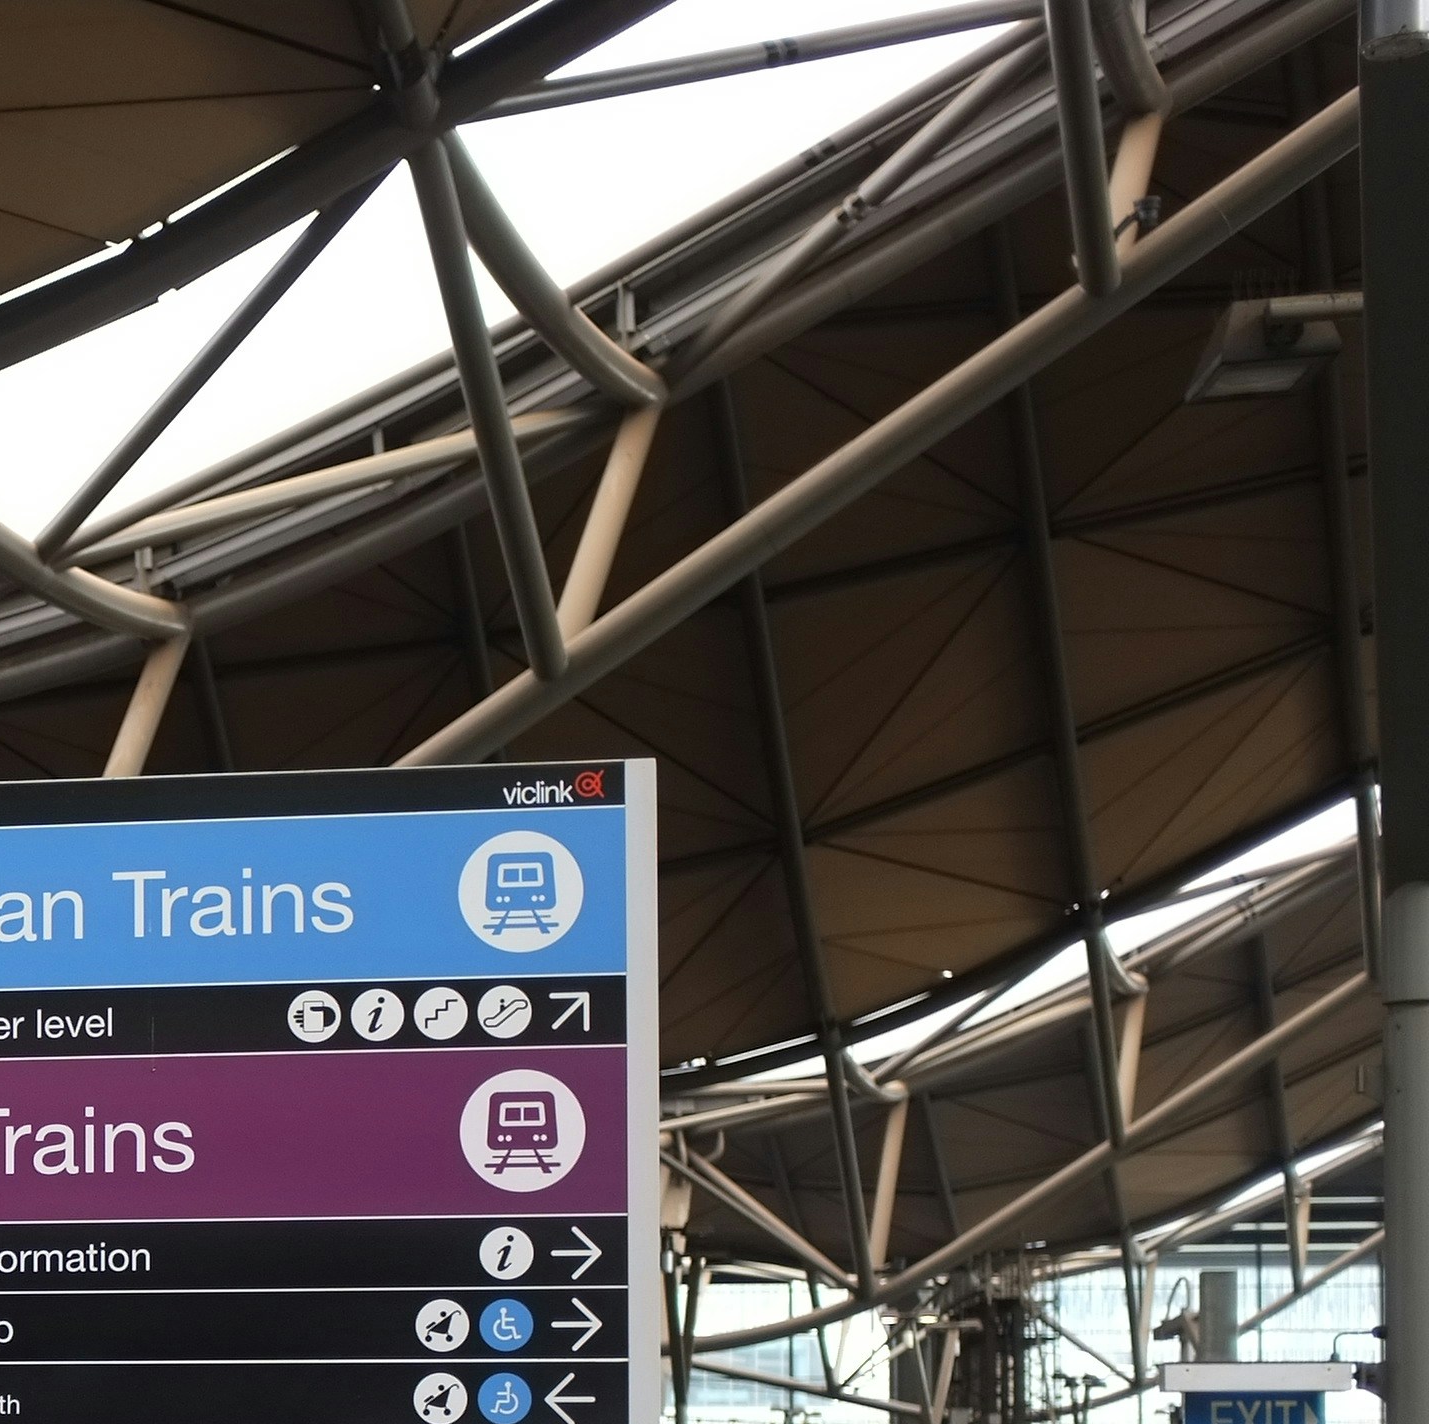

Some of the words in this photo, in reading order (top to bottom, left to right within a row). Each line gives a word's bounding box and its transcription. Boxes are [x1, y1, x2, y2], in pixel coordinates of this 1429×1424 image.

[503, 779, 573, 805] viclink
[112, 867, 353, 938] Trains
[37, 1006, 112, 1039] level
